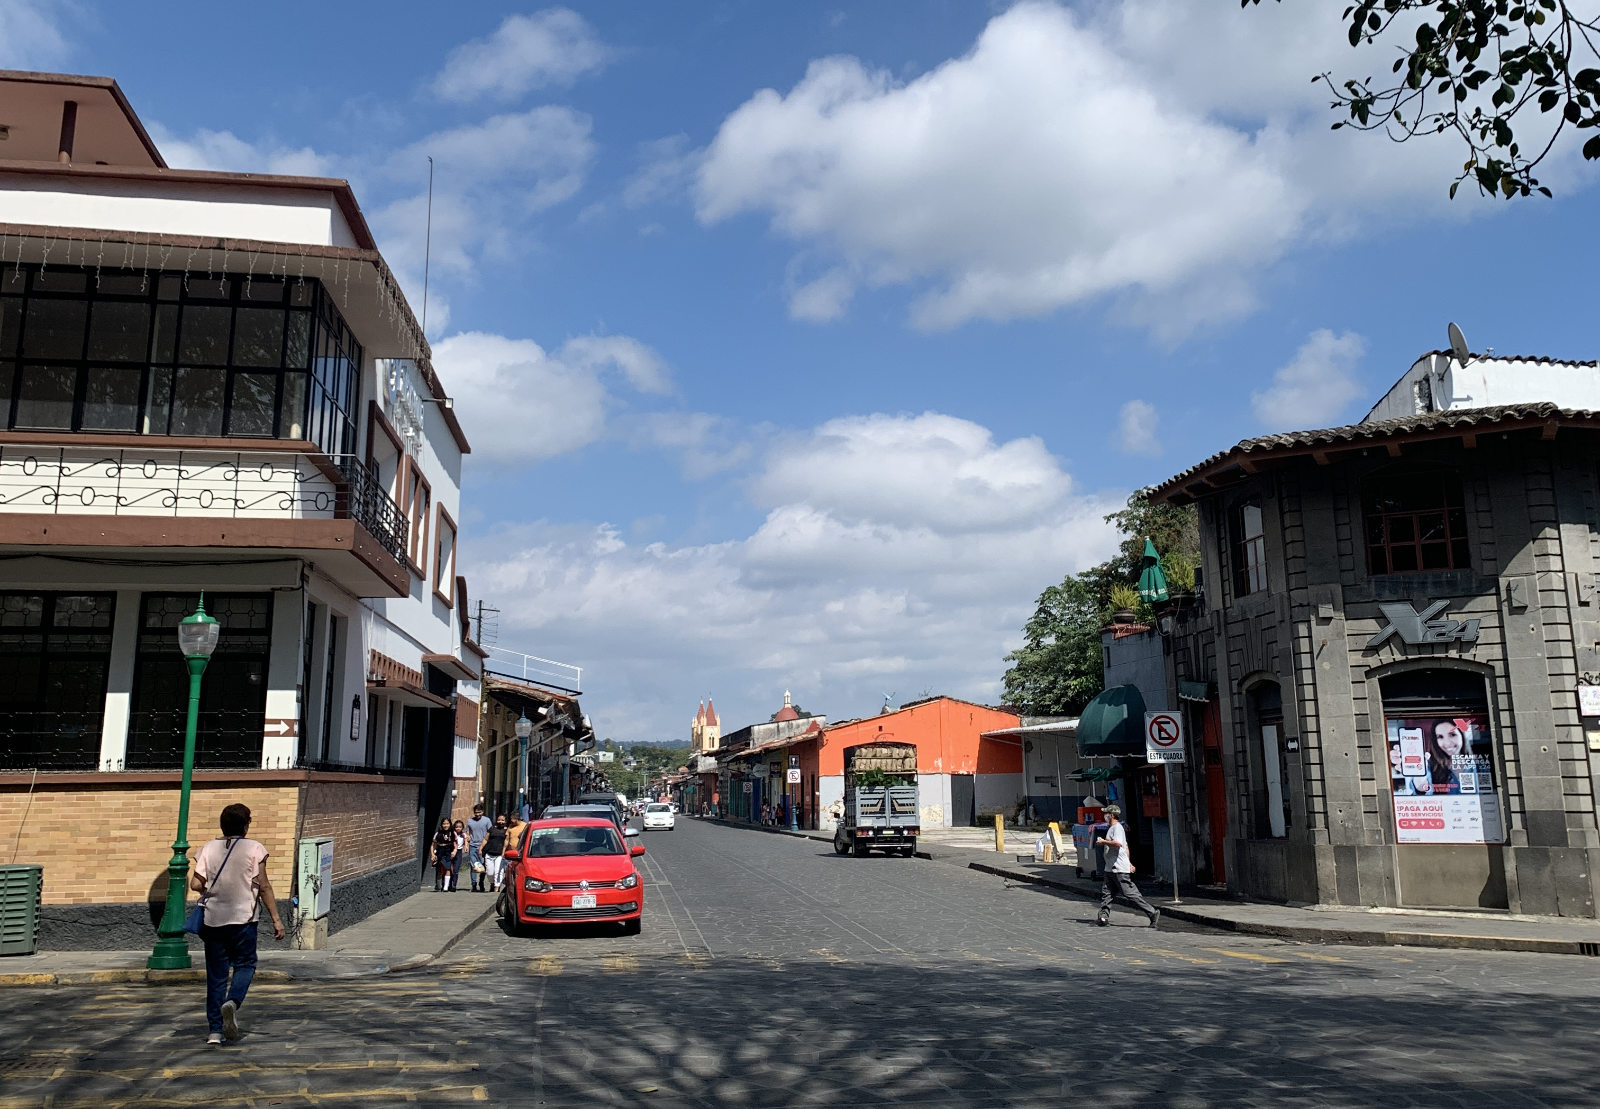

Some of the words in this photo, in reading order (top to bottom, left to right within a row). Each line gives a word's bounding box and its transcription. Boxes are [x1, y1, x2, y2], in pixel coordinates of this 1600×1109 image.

[1367, 600, 1481, 647] X24
[1149, 752, 1162, 760] ESTA
[1163, 752, 1183, 760] CUADRA
